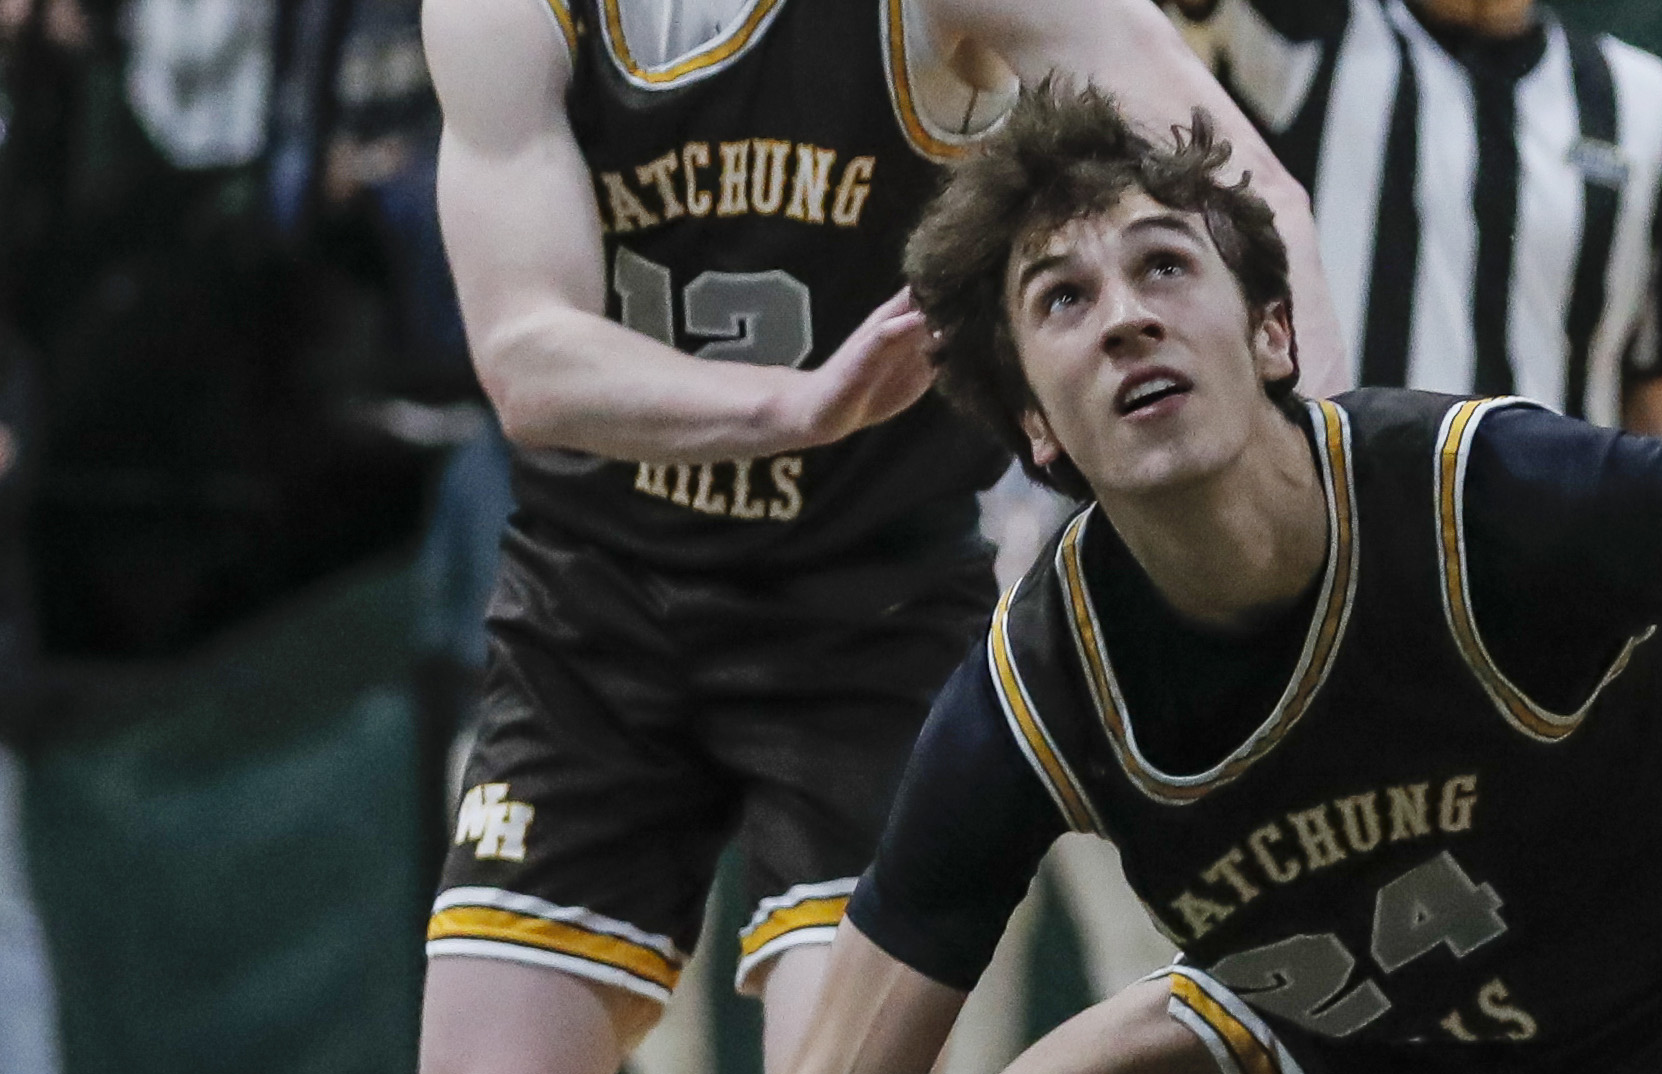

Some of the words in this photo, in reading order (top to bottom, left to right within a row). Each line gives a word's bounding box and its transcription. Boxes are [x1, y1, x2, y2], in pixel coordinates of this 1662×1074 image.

[602, 137, 877, 232] ATCHUNG
[1160, 773, 1479, 945] ATCHUNG
[1206, 850, 1508, 1038] 24
